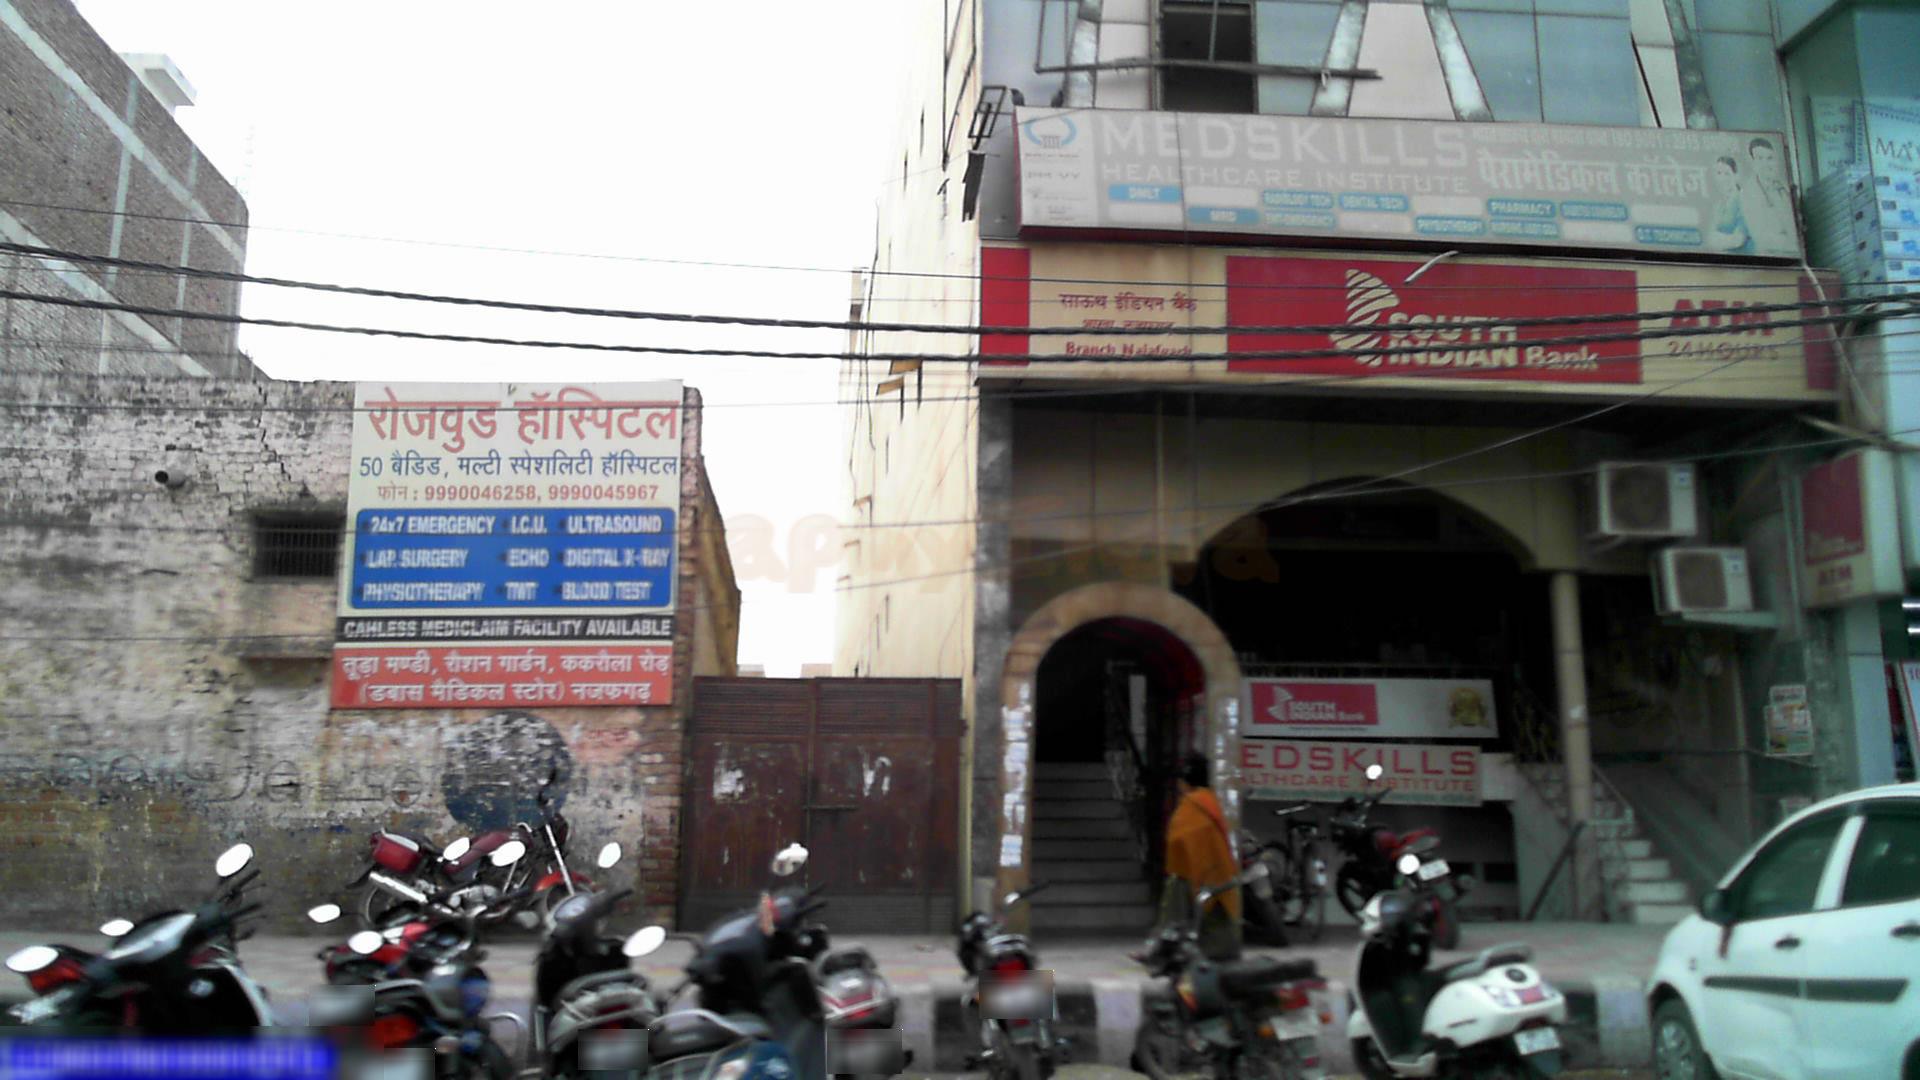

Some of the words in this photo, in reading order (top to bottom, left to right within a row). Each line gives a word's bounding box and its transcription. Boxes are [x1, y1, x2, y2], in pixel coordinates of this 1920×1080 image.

[1101, 115, 1469, 168] MEDSKILLS
[1103, 163, 1303, 188] HEALTHCARE
[1316, 170, 1470, 193] INSTITUTE
[1115, 292, 1165, 312] इंडियन
[1389, 312, 1517, 342] SOUTH
[1668, 299, 1774, 337] ATM
[1389, 338, 1518, 368] INDIAN
[1526, 345, 1599, 370] Bank
[1669, 340, 1694, 358] 24
[364, 387, 502, 453] रोजवुड
[514, 386, 680, 444] हॉस्पिटल
[360, 457, 383, 477] 50
[457, 449, 501, 476] मल्टी
[602, 449, 678, 476] हॉस्पिटल
[548, 484, 659, 501] 9990045967
[371, 516, 404, 534] 24x7
[407, 516, 496, 534] EMERGENCY
[567, 516, 662, 534] ULTRASOUND
[400, 549, 468, 568] SURGERY
[507, 549, 550, 568] ECHO
[564, 549, 620, 568] DIGITAL
[362, 582, 485, 601] PHYSIOTHERAPY
[561, 582, 609, 601] BLOOD
[613, 582, 653, 600] TEST
[420, 620, 508, 638] MEDICLAIM
[512, 620, 582, 637] FACILITY
[586, 619, 672, 637] AVAILABLE
